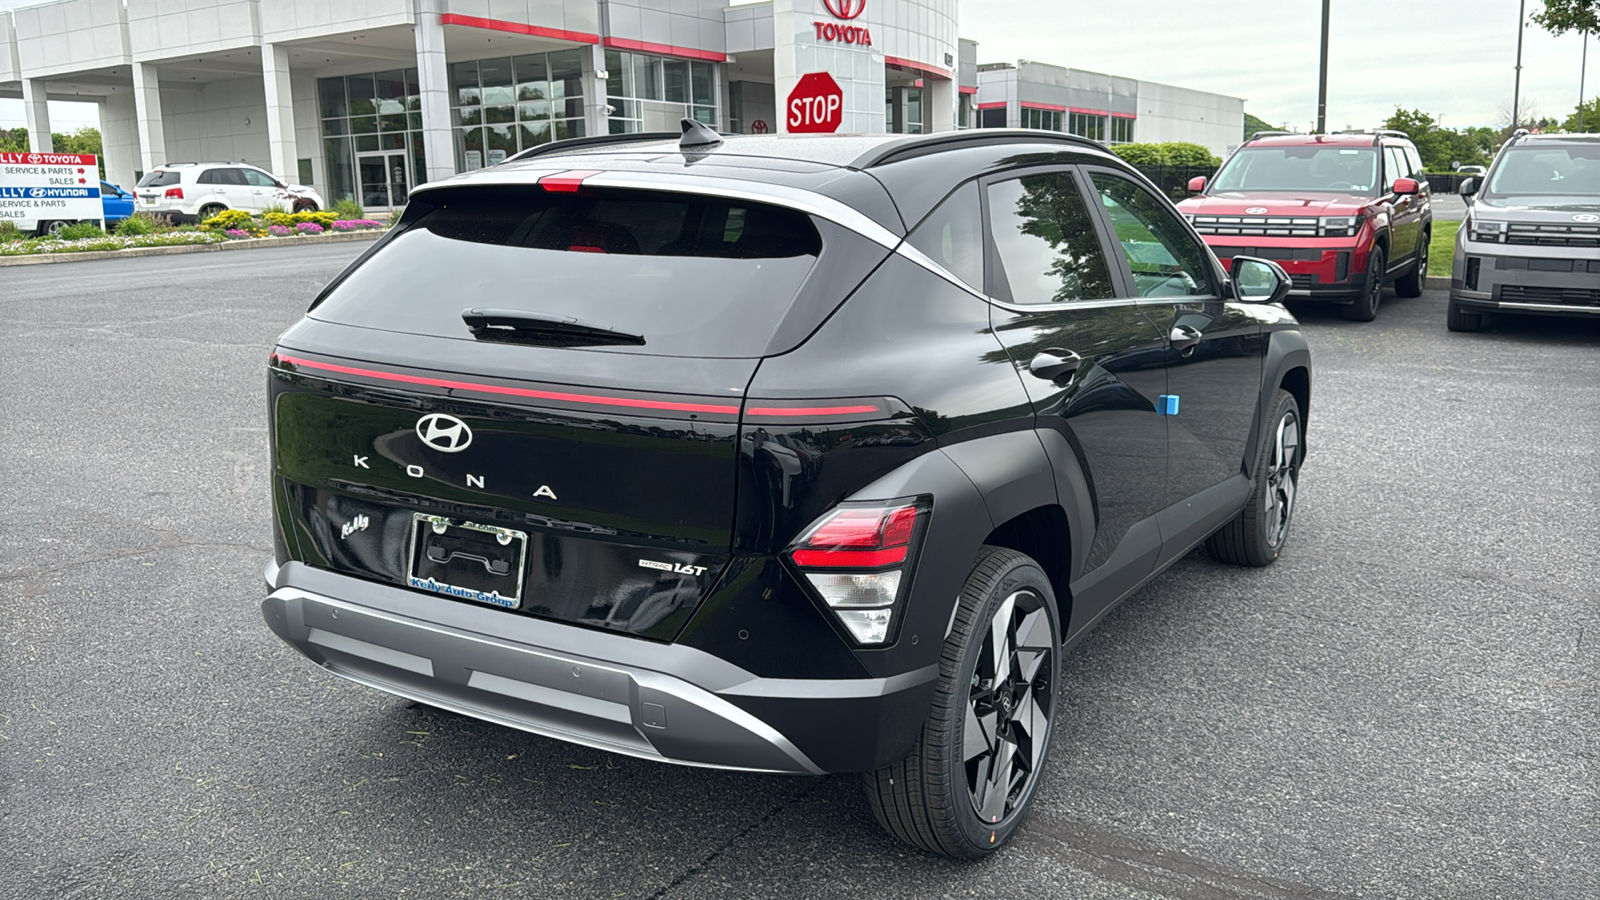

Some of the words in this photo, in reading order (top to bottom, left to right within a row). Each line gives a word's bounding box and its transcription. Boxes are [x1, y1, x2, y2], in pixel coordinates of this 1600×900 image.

[814, 21, 872, 46] TOYOTA
[789, 94, 840, 127] STOP
[43, 155, 82, 164] TOYOTA
[5, 167, 39, 175] SERVICE
[48, 167, 73, 175] PARTS
[47, 189, 88, 197] HYUNDAI
[41, 200, 66, 208] PARTS
[353, 454, 557, 500] KONA
[341, 514, 369, 539] Kelly
[641, 561, 670, 570] HTRAC
[412, 578, 441, 592] Kelly
[445, 585, 473, 599] Auto
[476, 592, 513, 607] Group
